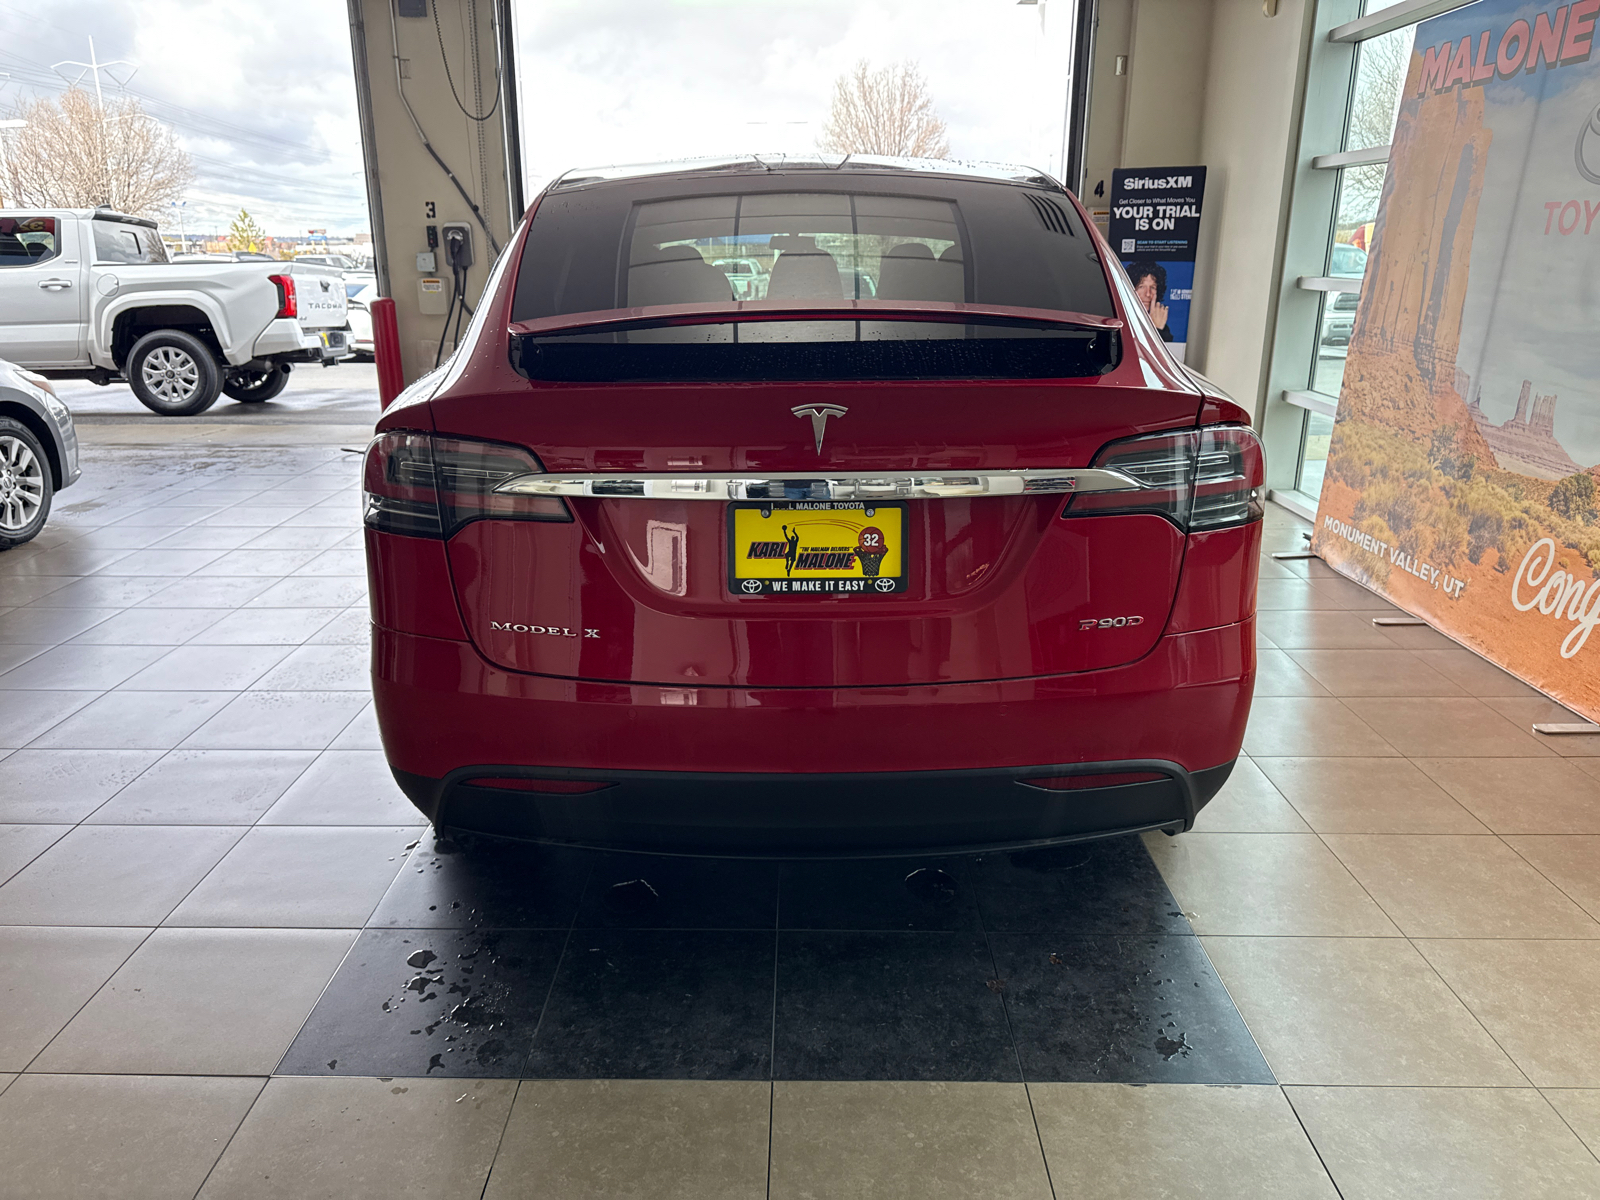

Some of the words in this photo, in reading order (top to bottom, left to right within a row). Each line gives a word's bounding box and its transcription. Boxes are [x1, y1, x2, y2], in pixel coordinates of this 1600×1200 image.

[1417, 0, 1600, 99] MALONE
[1094, 180, 1104, 198] 4
[1124, 176, 1192, 190] SiriusXM
[425, 201, 436, 218] 3
[1113, 206, 1153, 219] YOUR
[1156, 205, 1200, 218] TRIAL
[1135, 218, 1149, 231] IS
[1152, 218, 1175, 230] ON
[796, 502, 831, 510] MALONE
[863, 533, 879, 547] 32
[747, 541, 789, 559] KARL
[1324, 515, 1388, 558] MONUMENT
[1389, 547, 1440, 590] VALLEY,
[1443, 574, 1465, 598] UT
[794, 552, 856, 570] MALONE
[772, 581, 788, 591] WE
[792, 581, 821, 591] MAKE
[825, 581, 834, 591] IT
[838, 580, 865, 591] EASY
[490, 620, 577, 637] MODEL
[584, 628, 601, 638] X
[1079, 615, 1144, 631] P90D
